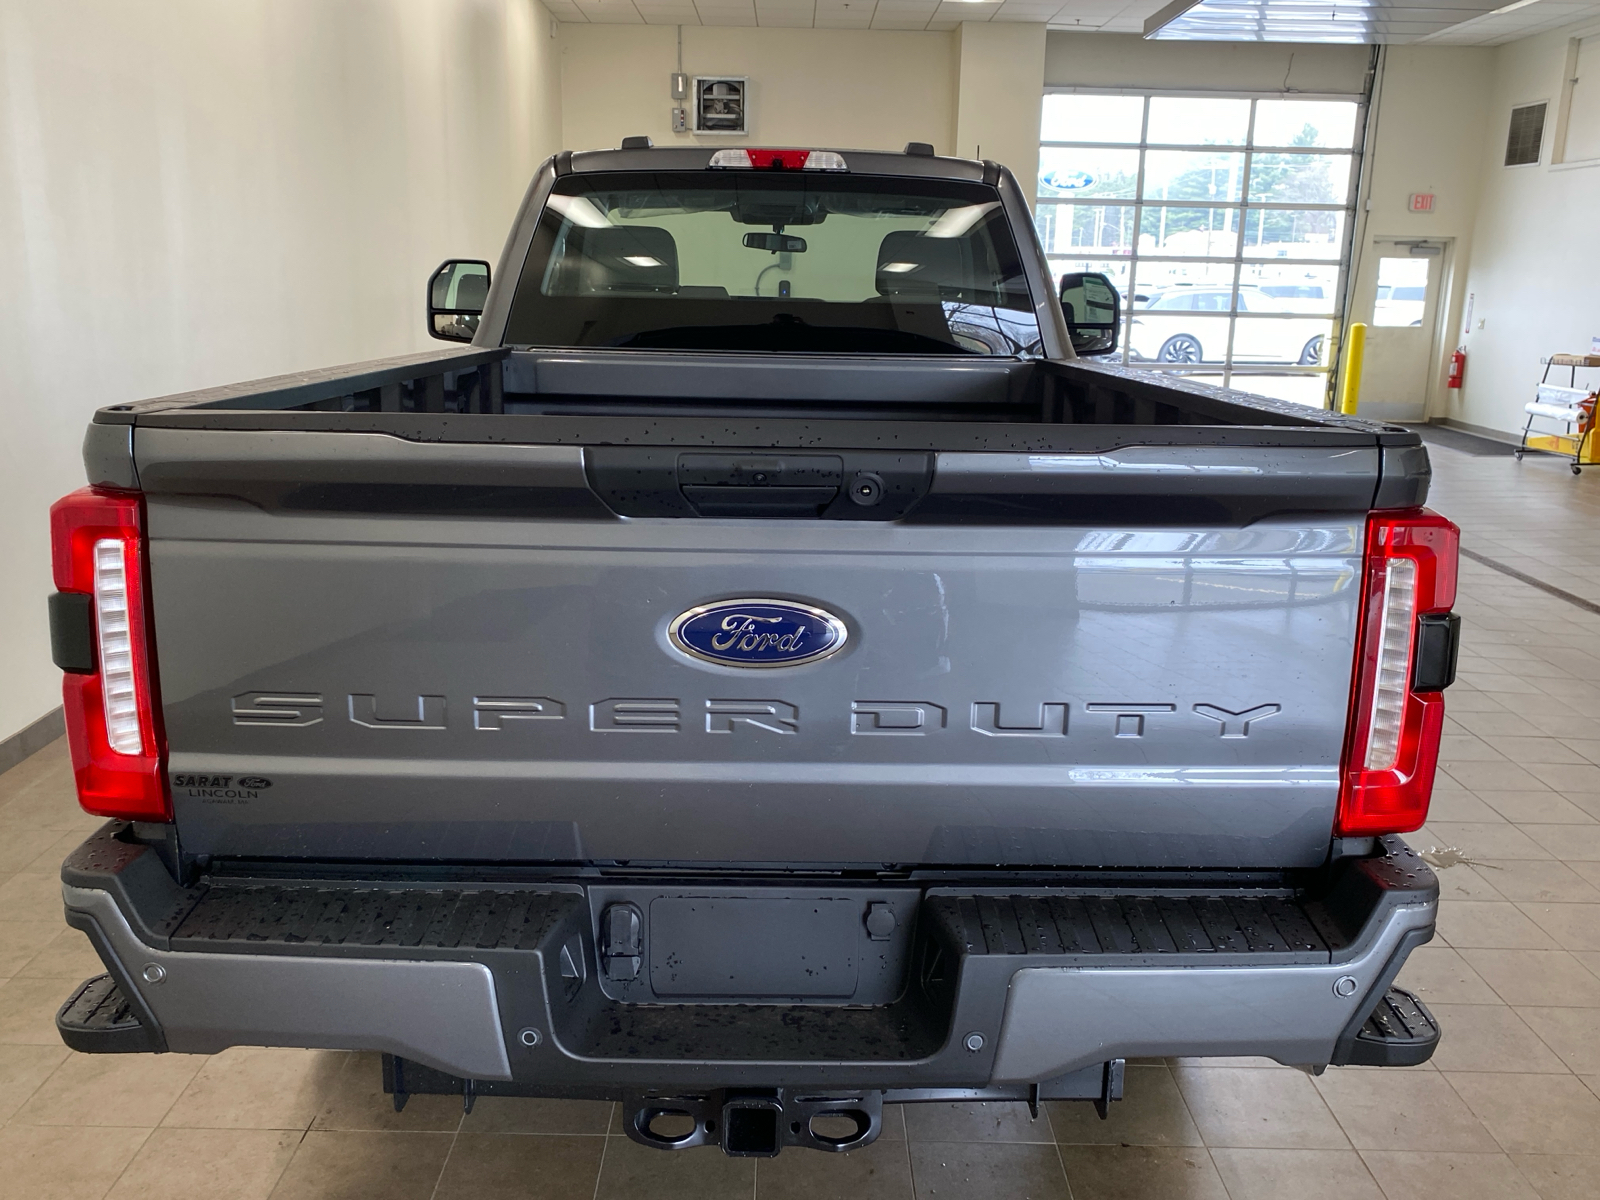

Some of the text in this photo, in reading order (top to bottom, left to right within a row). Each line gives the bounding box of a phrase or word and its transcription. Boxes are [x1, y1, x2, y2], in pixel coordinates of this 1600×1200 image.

[1413, 194, 1434, 210] EXIT
[711, 614, 806, 652] Ford
[231, 691, 1282, 739] SUPER DUTY
[174, 775, 233, 788] SARAT
[188, 789, 258, 799] LINCOLN
